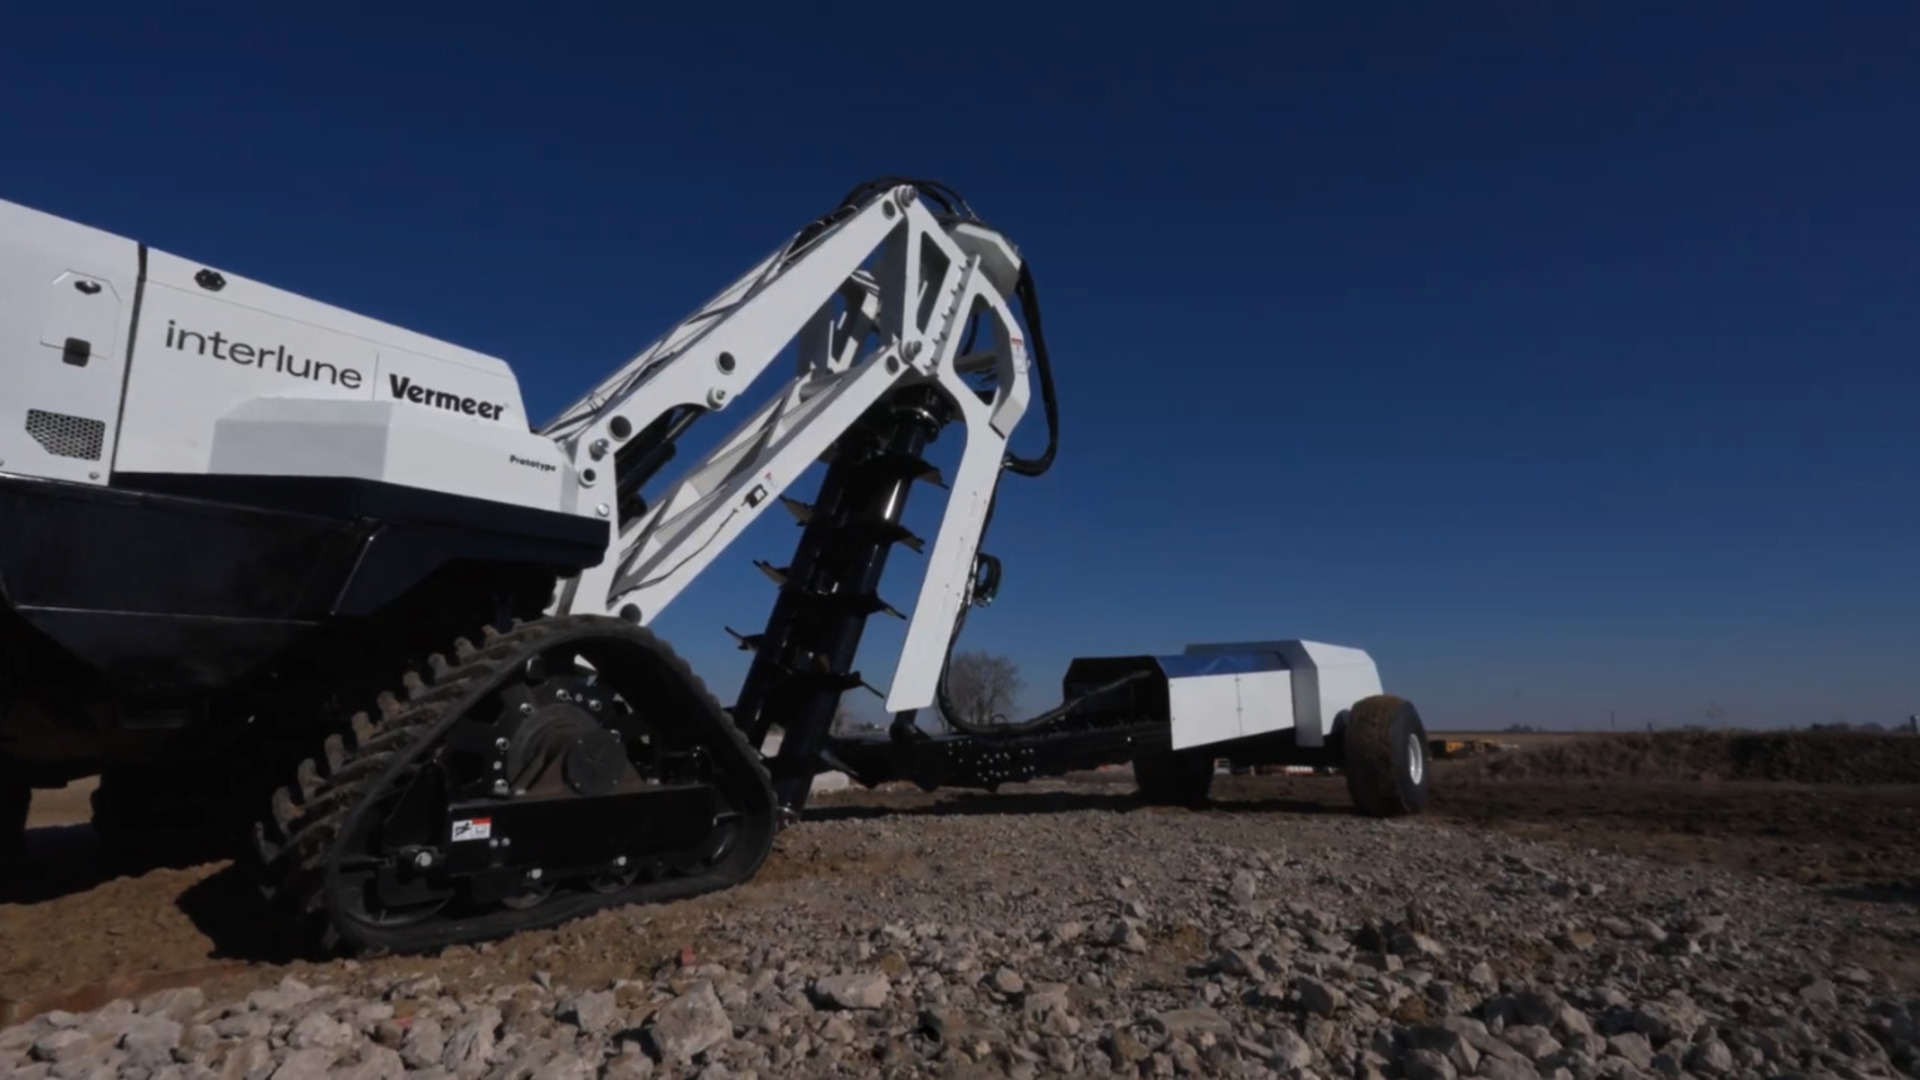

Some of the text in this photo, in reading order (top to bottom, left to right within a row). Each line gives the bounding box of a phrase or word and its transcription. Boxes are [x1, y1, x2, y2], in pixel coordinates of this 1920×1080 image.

[165, 319, 363, 389] interlune
[389, 373, 504, 421] Vermeer
[509, 454, 557, 473] Prototype
